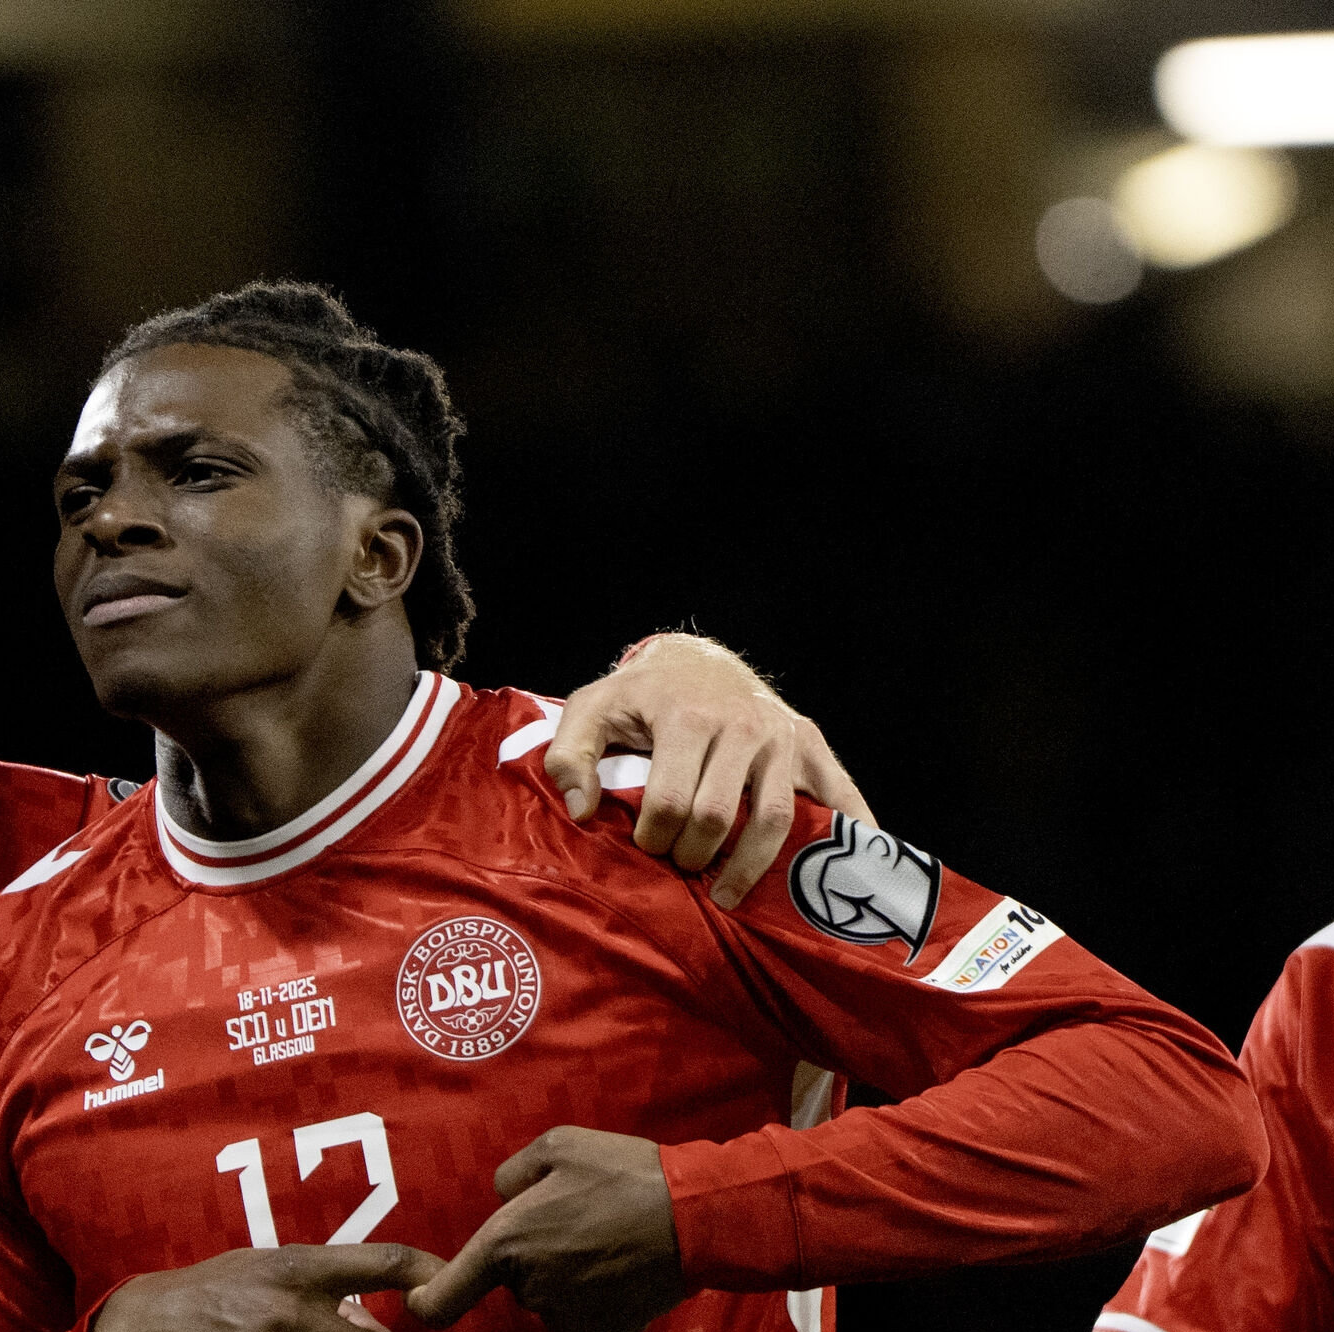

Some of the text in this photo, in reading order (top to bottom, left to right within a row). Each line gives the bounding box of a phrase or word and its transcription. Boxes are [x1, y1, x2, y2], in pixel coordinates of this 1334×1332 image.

[237, 975, 317, 1012] 18-11-2025
[425, 959, 511, 1012] DBU
[225, 1011, 270, 1051] SCO
[290, 996, 337, 1035] DEN
[402, 968, 442, 1047] DANSK
[252, 1034, 316, 1066] GLASGOW
[449, 1030, 506, 1056] 1889
[83, 1068, 165, 1111] hummel
